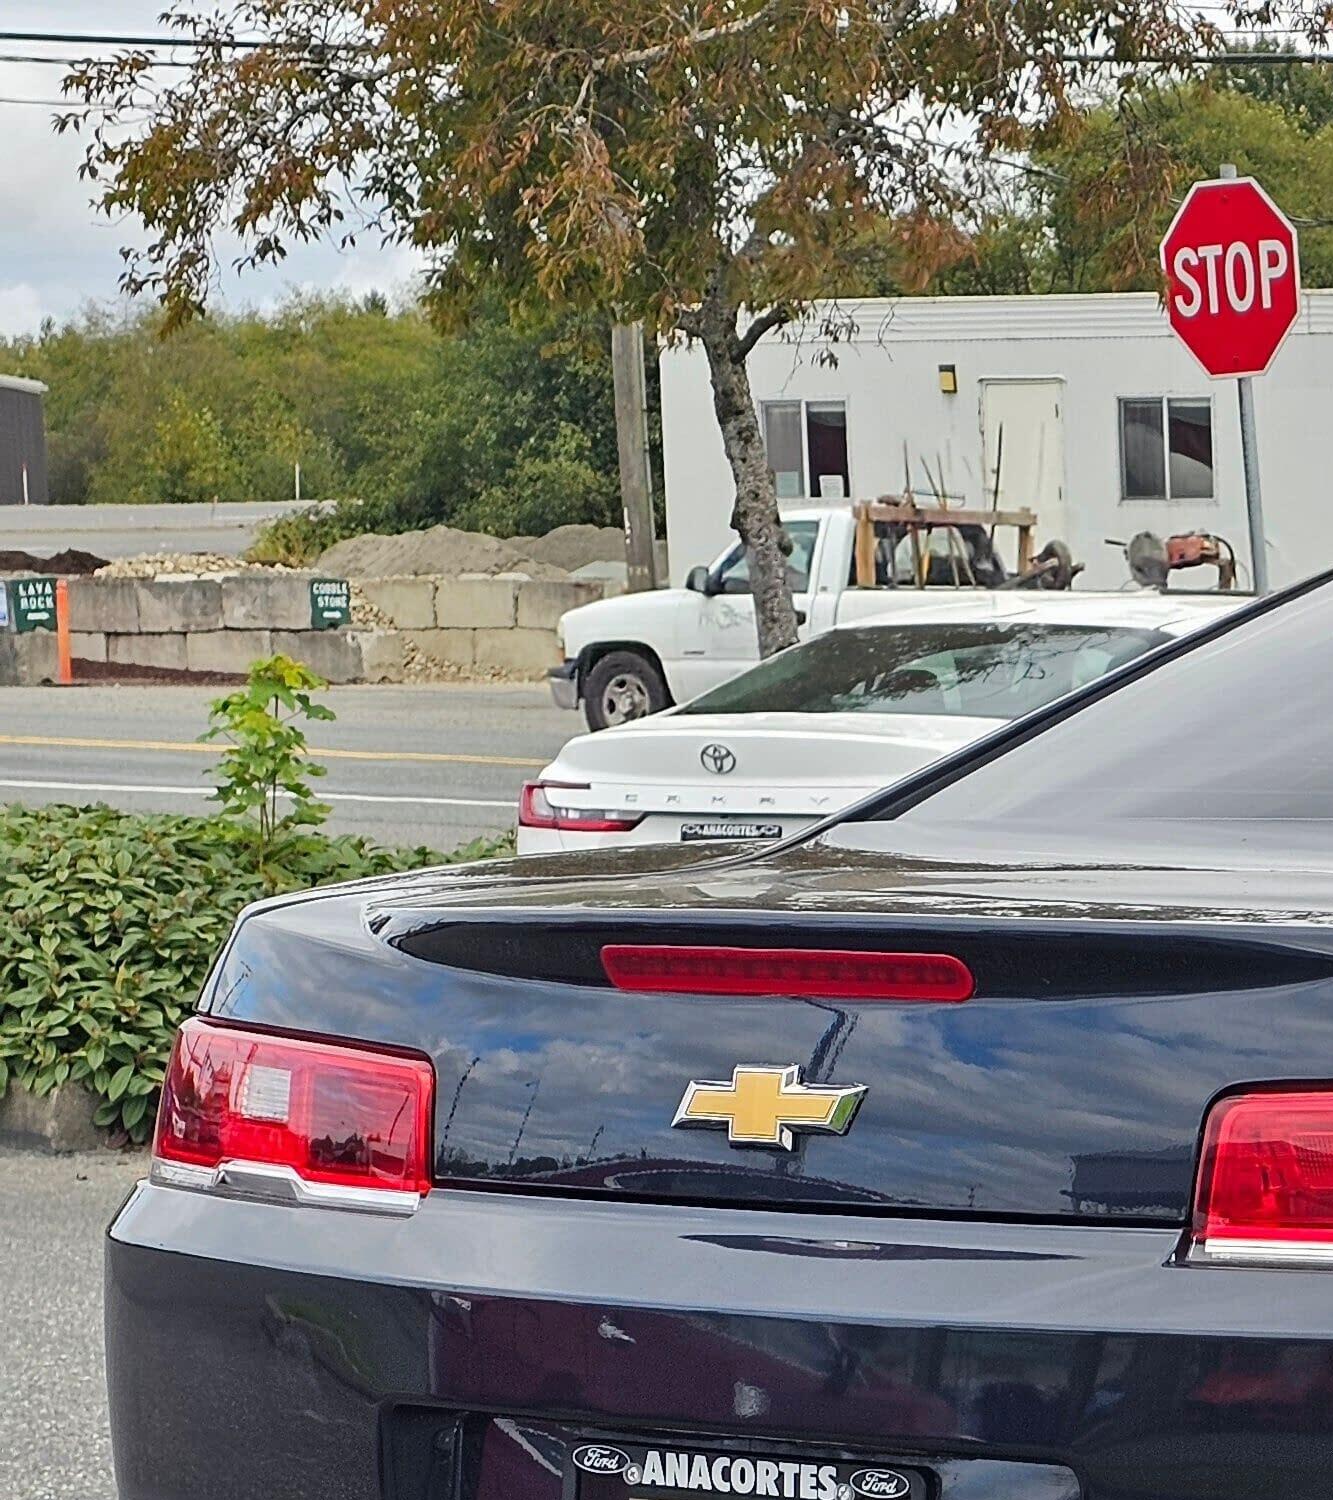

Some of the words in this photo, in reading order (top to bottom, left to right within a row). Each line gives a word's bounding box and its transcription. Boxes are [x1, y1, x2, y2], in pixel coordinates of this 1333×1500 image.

[1173, 239, 1288, 318] STOP
[18, 581, 53, 597] LAVA
[312, 582, 348, 595] COBBLE
[19, 595, 55, 610] ROCK
[317, 595, 348, 608] STONE
[579, 1445, 623, 1473] Ford
[857, 1472, 901, 1497] Ford
